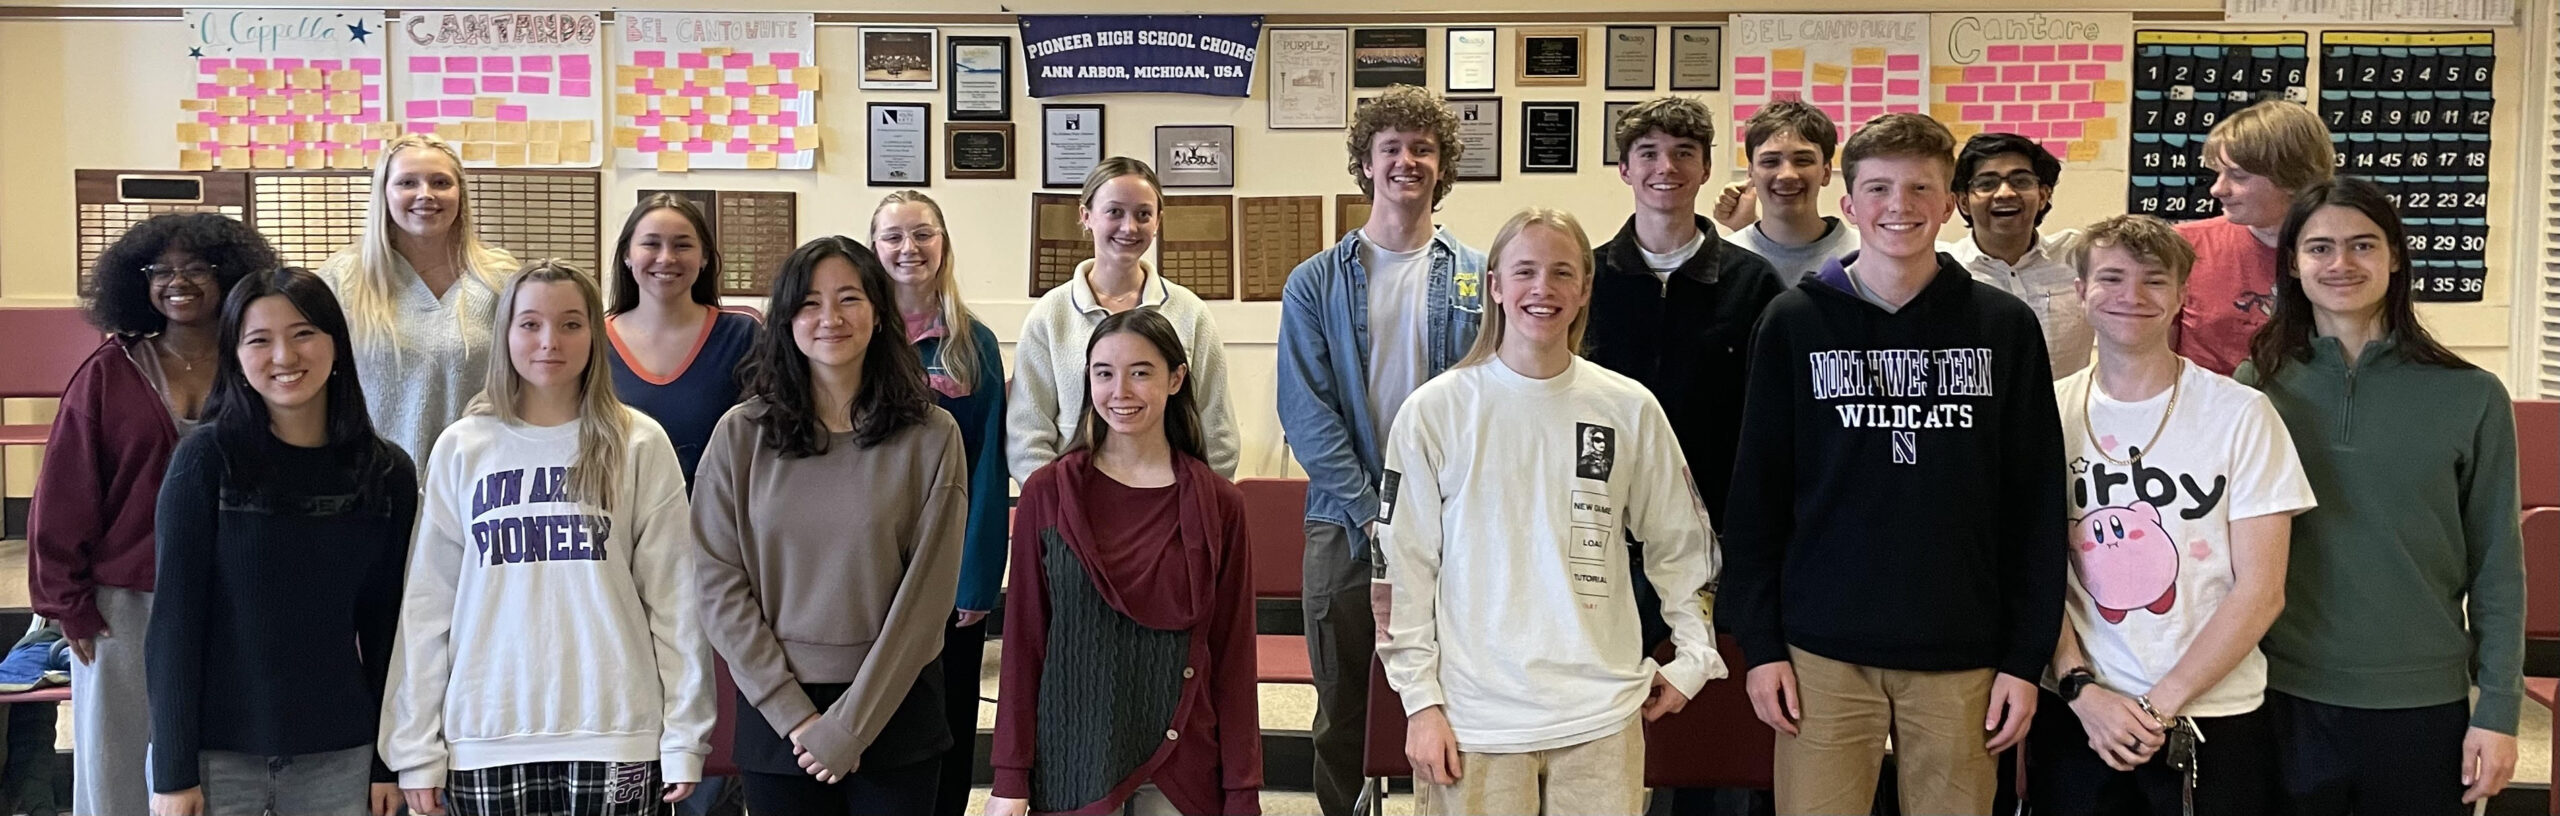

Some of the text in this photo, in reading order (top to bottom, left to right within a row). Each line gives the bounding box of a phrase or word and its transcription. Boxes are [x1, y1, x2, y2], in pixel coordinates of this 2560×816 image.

[230, 11, 337, 52] Cappella
[406, 14, 596, 46] CANTANDO
[626, 16, 797, 43] BEL CANTO WHITE
[1741, 18, 1917, 45] BEL CANTO PURPLE
[1026, 30, 1256, 62] PIONEER HIGH SCHOOL CHOIRS
[1948, 13, 2100, 65] Cantare
[1041, 65, 1244, 80] ANN ARBOR, MICHIGAN, USA
[2148, 66, 2301, 84] 1 2 3 4 5 6
[2336, 67, 2488, 83] 1 2 3 4 5 6
[2147, 111, 2215, 127] 7 8 9
[2333, 110, 2490, 125] 7 8 9 10 11 12
[2143, 152, 2160, 167] 13
[2170, 154, 2187, 169] 14
[2356, 153, 2373, 167] 14
[2411, 152, 2428, 167] 16
[2438, 152, 2458, 166] 17
[2466, 152, 2486, 167] 18
[2140, 196, 2215, 213] 19 20 21
[2408, 192, 2430, 208] 22
[2436, 193, 2458, 208] 23
[2463, 192, 2486, 208] 24
[2406, 235, 2485, 251] 28 29 30
[2411, 277, 2483, 293] 4 35 36
[1835, 404, 1974, 429] WILDCATS
[1892, 430, 1917, 464] N
[1573, 502, 1592, 511] NEW
[471, 515, 612, 568] PIONEER
[1573, 573, 1608, 584] TUTORIAL
